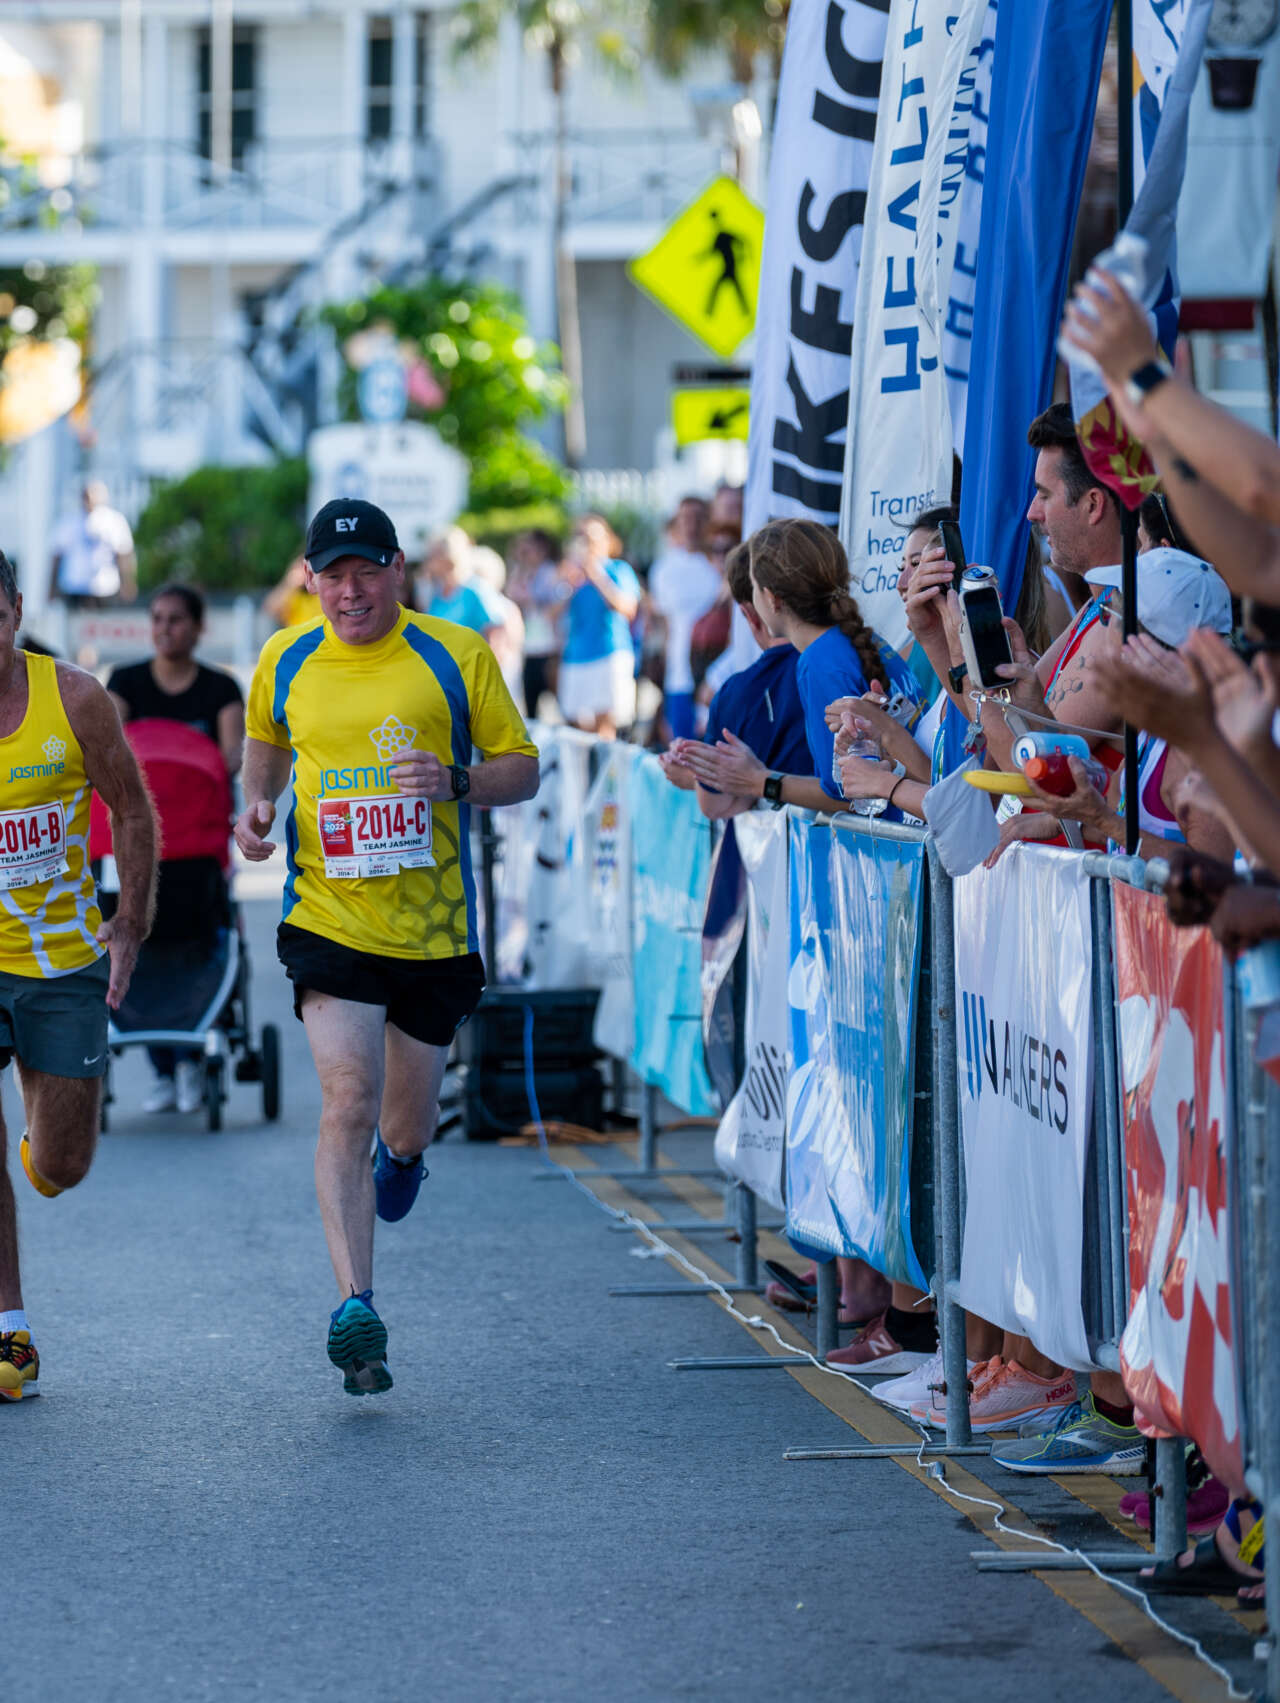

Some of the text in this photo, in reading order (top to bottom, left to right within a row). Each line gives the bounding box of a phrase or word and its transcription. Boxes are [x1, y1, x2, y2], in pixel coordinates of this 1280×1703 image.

[773, 0, 890, 528] IKES IC
[335, 517, 359, 532] EY
[867, 528, 906, 556] hea
[8, 761, 65, 784] jasmine
[317, 764, 400, 798] jasmin
[356, 800, 426, 841] 2014-C
[0, 846, 57, 864] TEAM JASMINE
[363, 838, 423, 851] TEAM JASMINE
